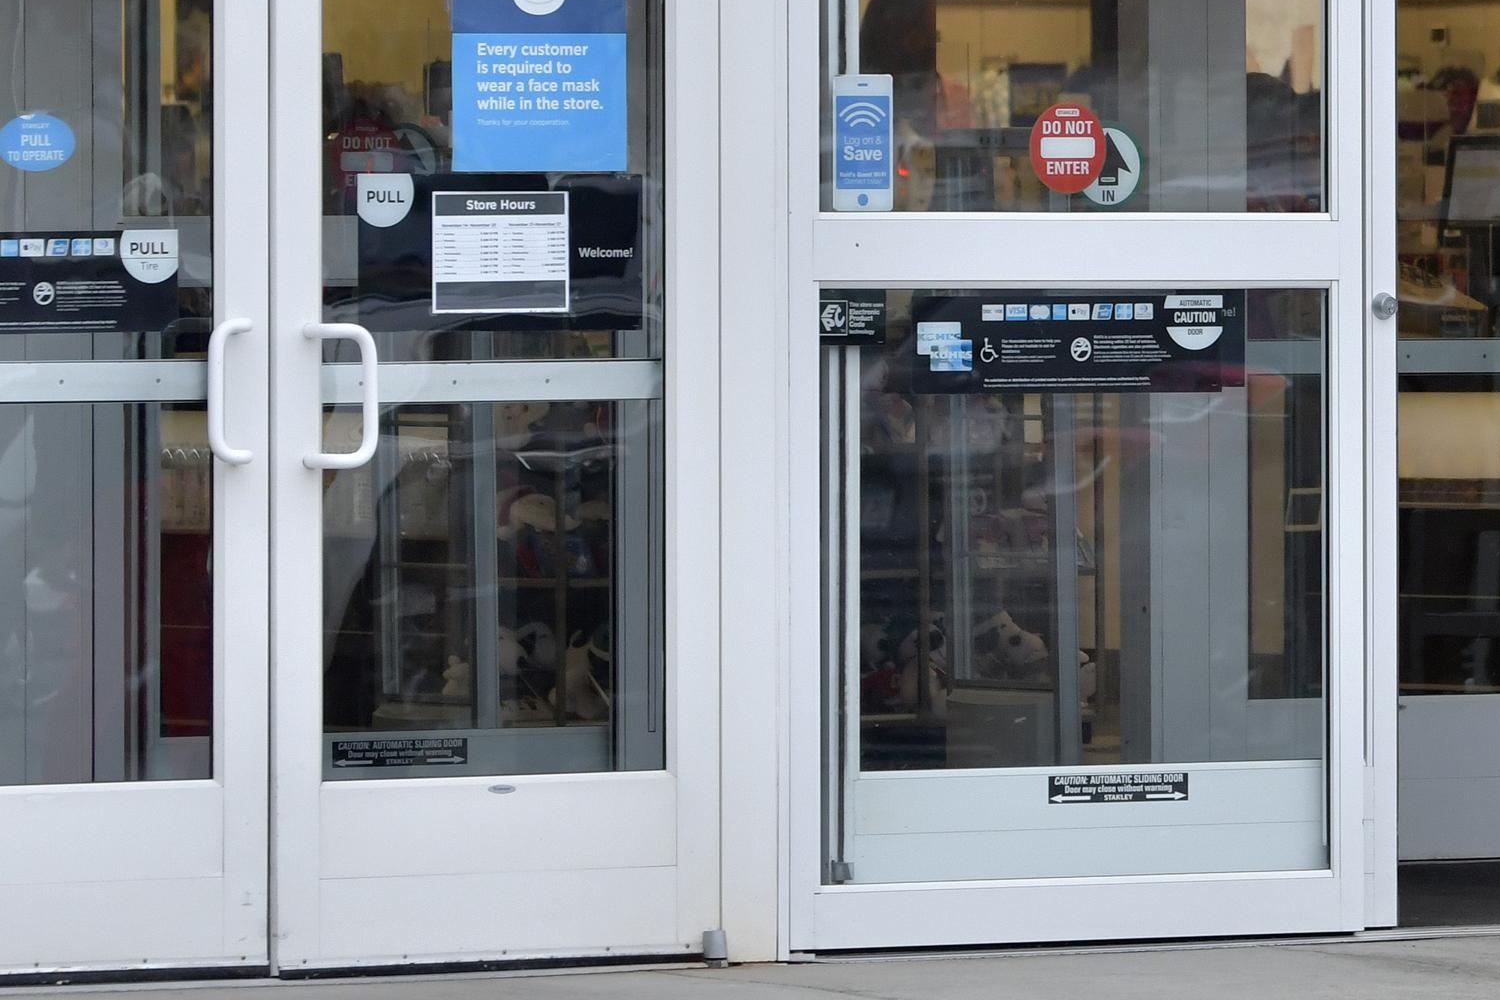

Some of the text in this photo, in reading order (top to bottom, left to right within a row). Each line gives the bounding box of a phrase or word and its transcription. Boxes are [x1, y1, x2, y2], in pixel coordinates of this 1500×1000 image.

[477, 43, 588, 58] Every customer
[477, 61, 572, 76] is required to
[477, 79, 600, 92] wear a face mask
[477, 97, 604, 110] while in the store.
[1042, 121, 1093, 134] DO NOT
[21, 134, 51, 147] PULL
[343, 136, 392, 150] DO NOT
[844, 136, 860, 147] Log
[8, 150, 64, 162] TO OPERATE
[843, 146, 883, 161] Save
[1046, 161, 1089, 175] ENTER
[366, 190, 405, 204] PULL
[1102, 190, 1115, 202] IN
[466, 199, 536, 211] Store Hours
[130, 242, 169, 255] PULL
[578, 247, 634, 258] Welcome!
[140, 261, 159, 271] Tire
[1179, 299, 1212, 307] AUTOMATIC
[1174, 311, 1216, 324] CAUTION
[1187, 328, 1203, 336] DOOR
[1090, 775, 1132, 784] AUTOMATIC
[1134, 774, 1162, 783] SLIDING
[1163, 773, 1183, 782] DOOR
[1065, 785, 1081, 793] Door
[1082, 786, 1096, 794] may
[1117, 784, 1143, 792] without
[1145, 784, 1173, 792] warning
